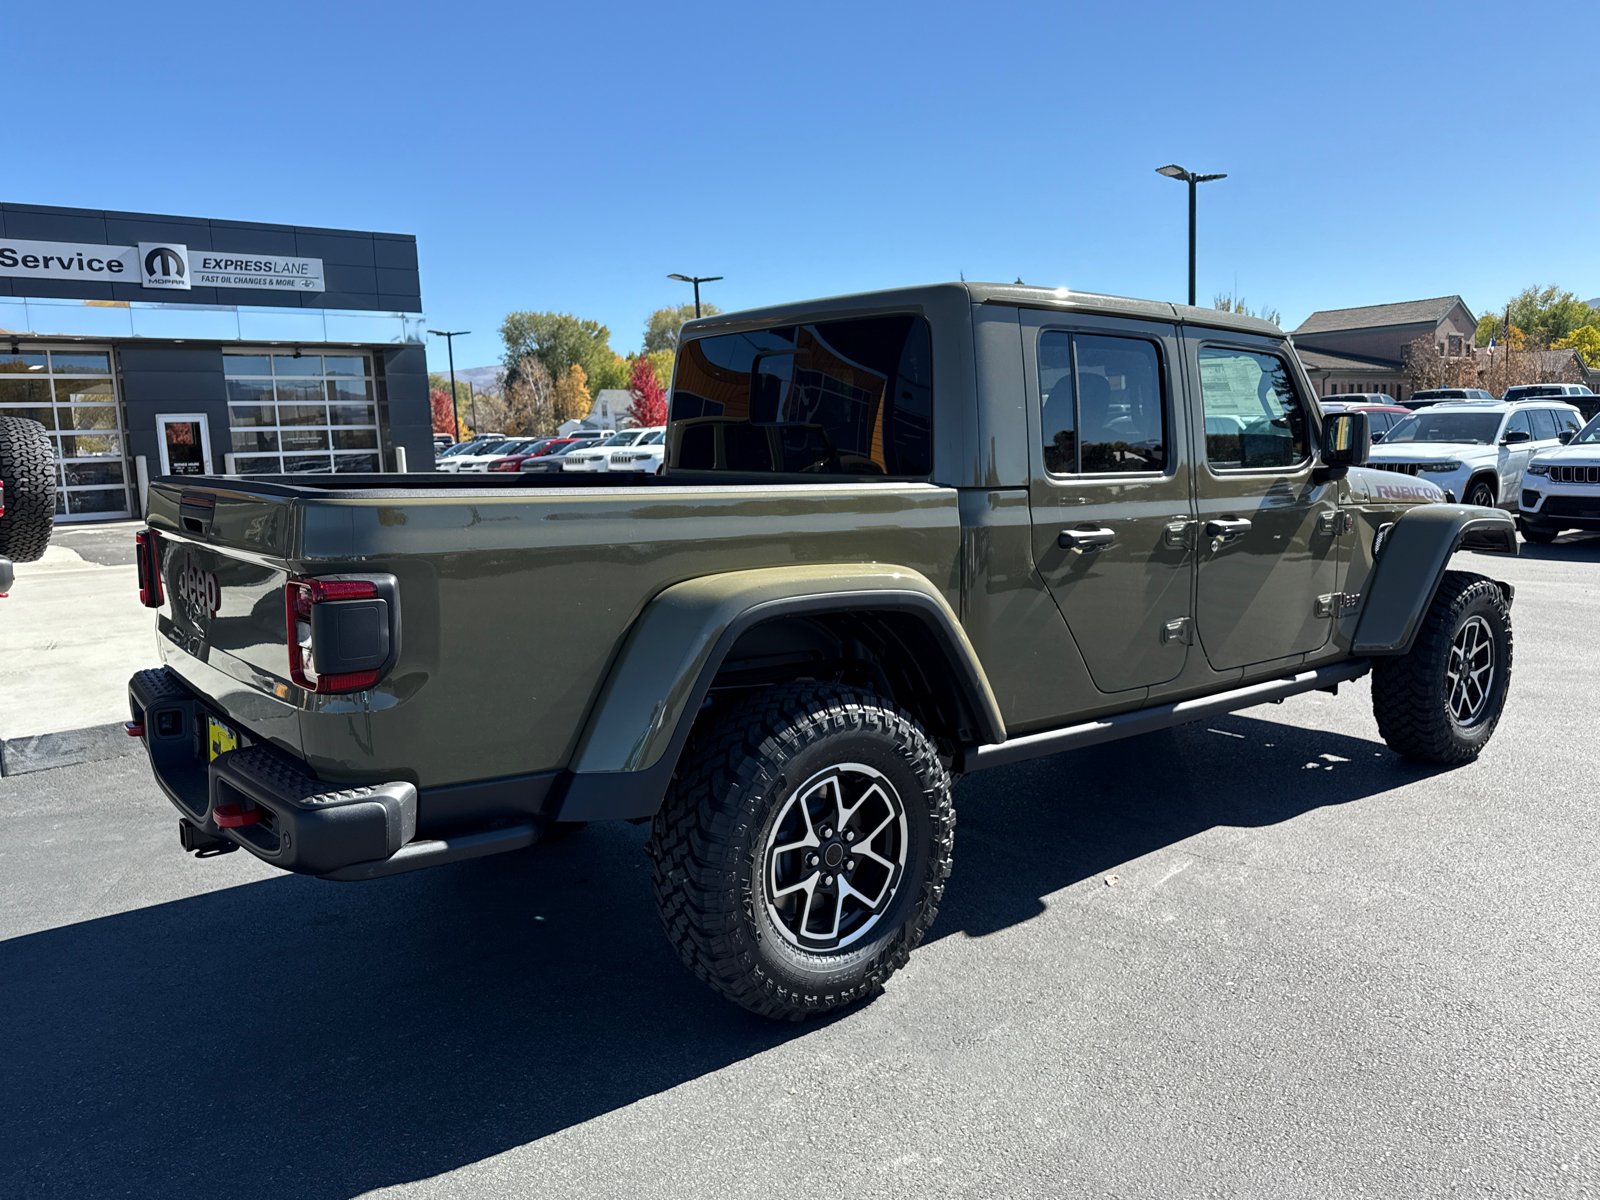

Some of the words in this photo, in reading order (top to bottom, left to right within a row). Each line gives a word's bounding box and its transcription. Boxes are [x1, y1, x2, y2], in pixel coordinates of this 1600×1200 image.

[0, 247, 124, 273] Service
[202, 258, 309, 274] EXPRESSLANE
[201, 275, 220, 283] FAST
[221, 276, 233, 284] OIL
[233, 277, 267, 286] CHANGES
[275, 279, 296, 287] MORE
[1375, 484, 1443, 500] RUBICON
[178, 553, 219, 621] Jeep
